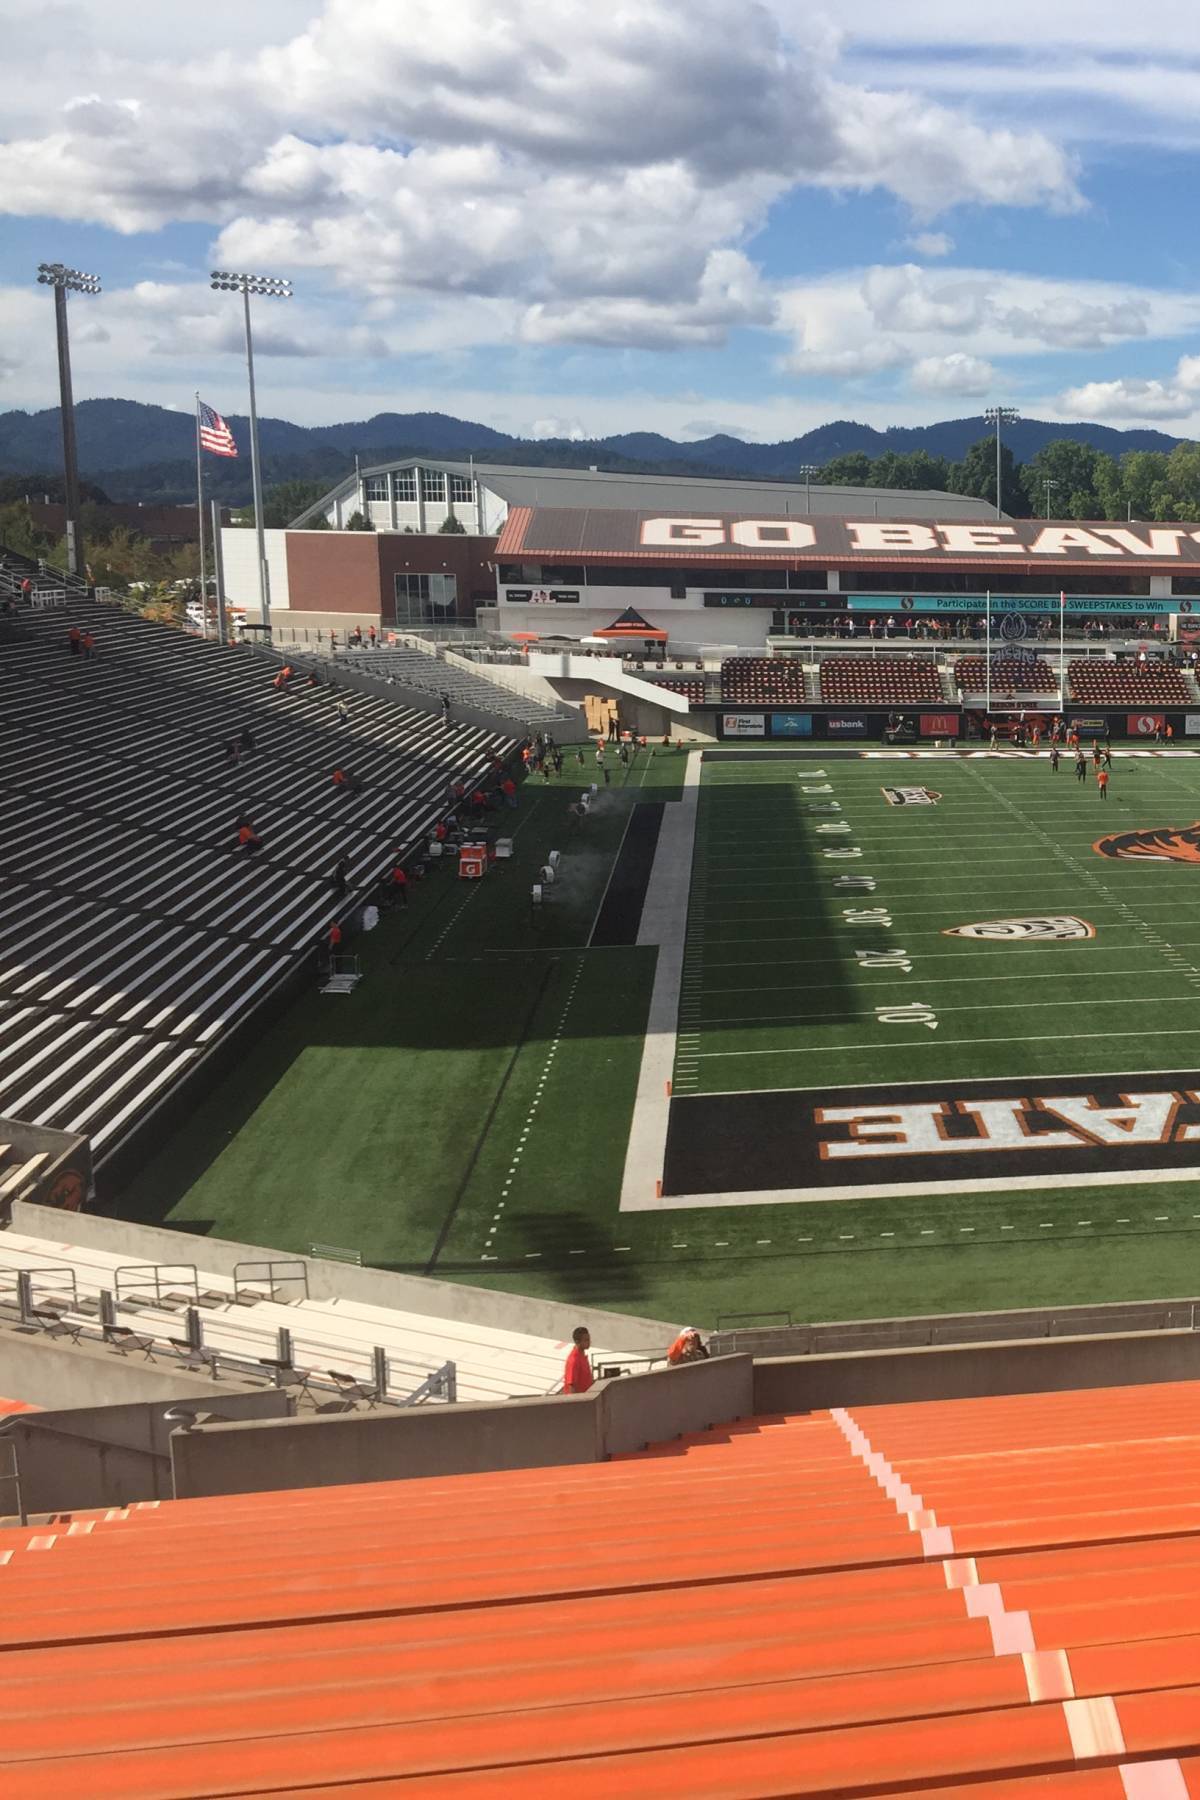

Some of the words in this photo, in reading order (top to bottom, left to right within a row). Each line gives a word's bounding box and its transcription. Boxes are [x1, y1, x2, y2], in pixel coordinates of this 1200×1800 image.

[641, 518, 817, 548] GO
[936, 600, 987, 610] Participate
[1001, 600, 1016, 609] the
[1018, 600, 1050, 609] SCORE
[1069, 601, 1132, 610] SWEEPSTAKES
[1135, 602, 1144, 610] to
[1146, 602, 1164, 611] Win
[842, 907, 892, 924] 30
[853, 949, 912, 969] 20
[874, 1002, 937, 1024] 10
